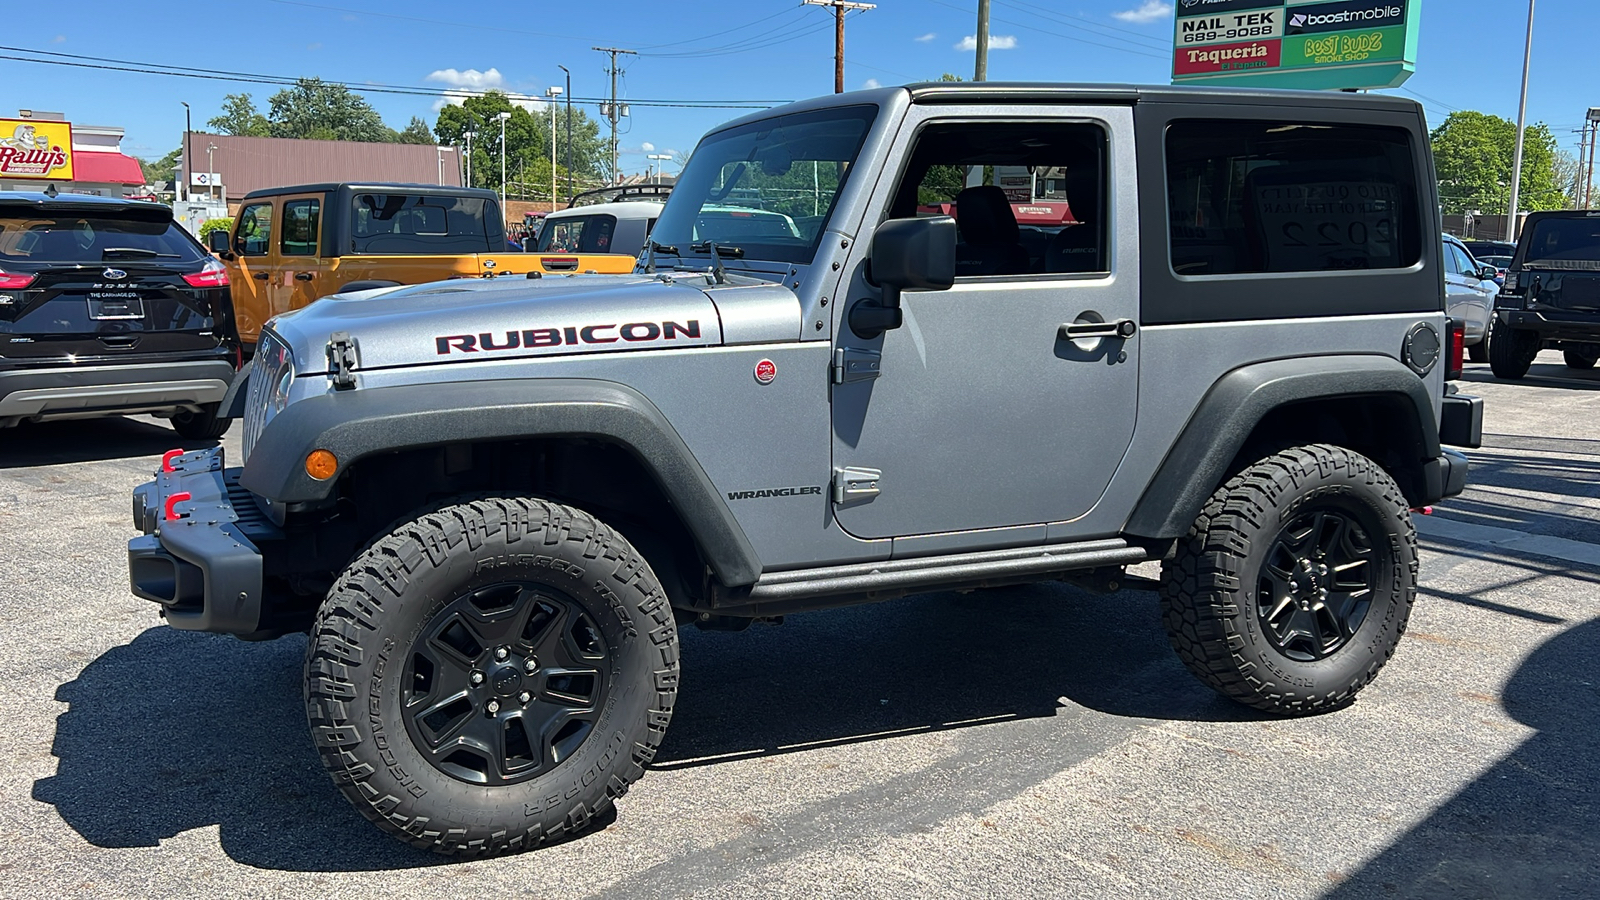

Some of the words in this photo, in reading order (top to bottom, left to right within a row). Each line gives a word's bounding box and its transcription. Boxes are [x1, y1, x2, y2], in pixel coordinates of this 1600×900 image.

[1182, 18, 1225, 32] NAIL
[1233, 12, 1274, 26] TEK
[1307, 5, 1401, 25] boostmobile
[1184, 26, 1273, 42] 689-9088
[1314, 54, 1343, 63] SMOKE
[1344, 52, 1369, 61] SHOP
[0, 145, 66, 174] Rally's
[435, 320, 702, 355] RUBICON
[727, 486, 822, 501] WRANGLER
[475, 553, 586, 579] RUGGED
[593, 579, 638, 639] TREK
[368, 636, 428, 799] DISCOVERER
